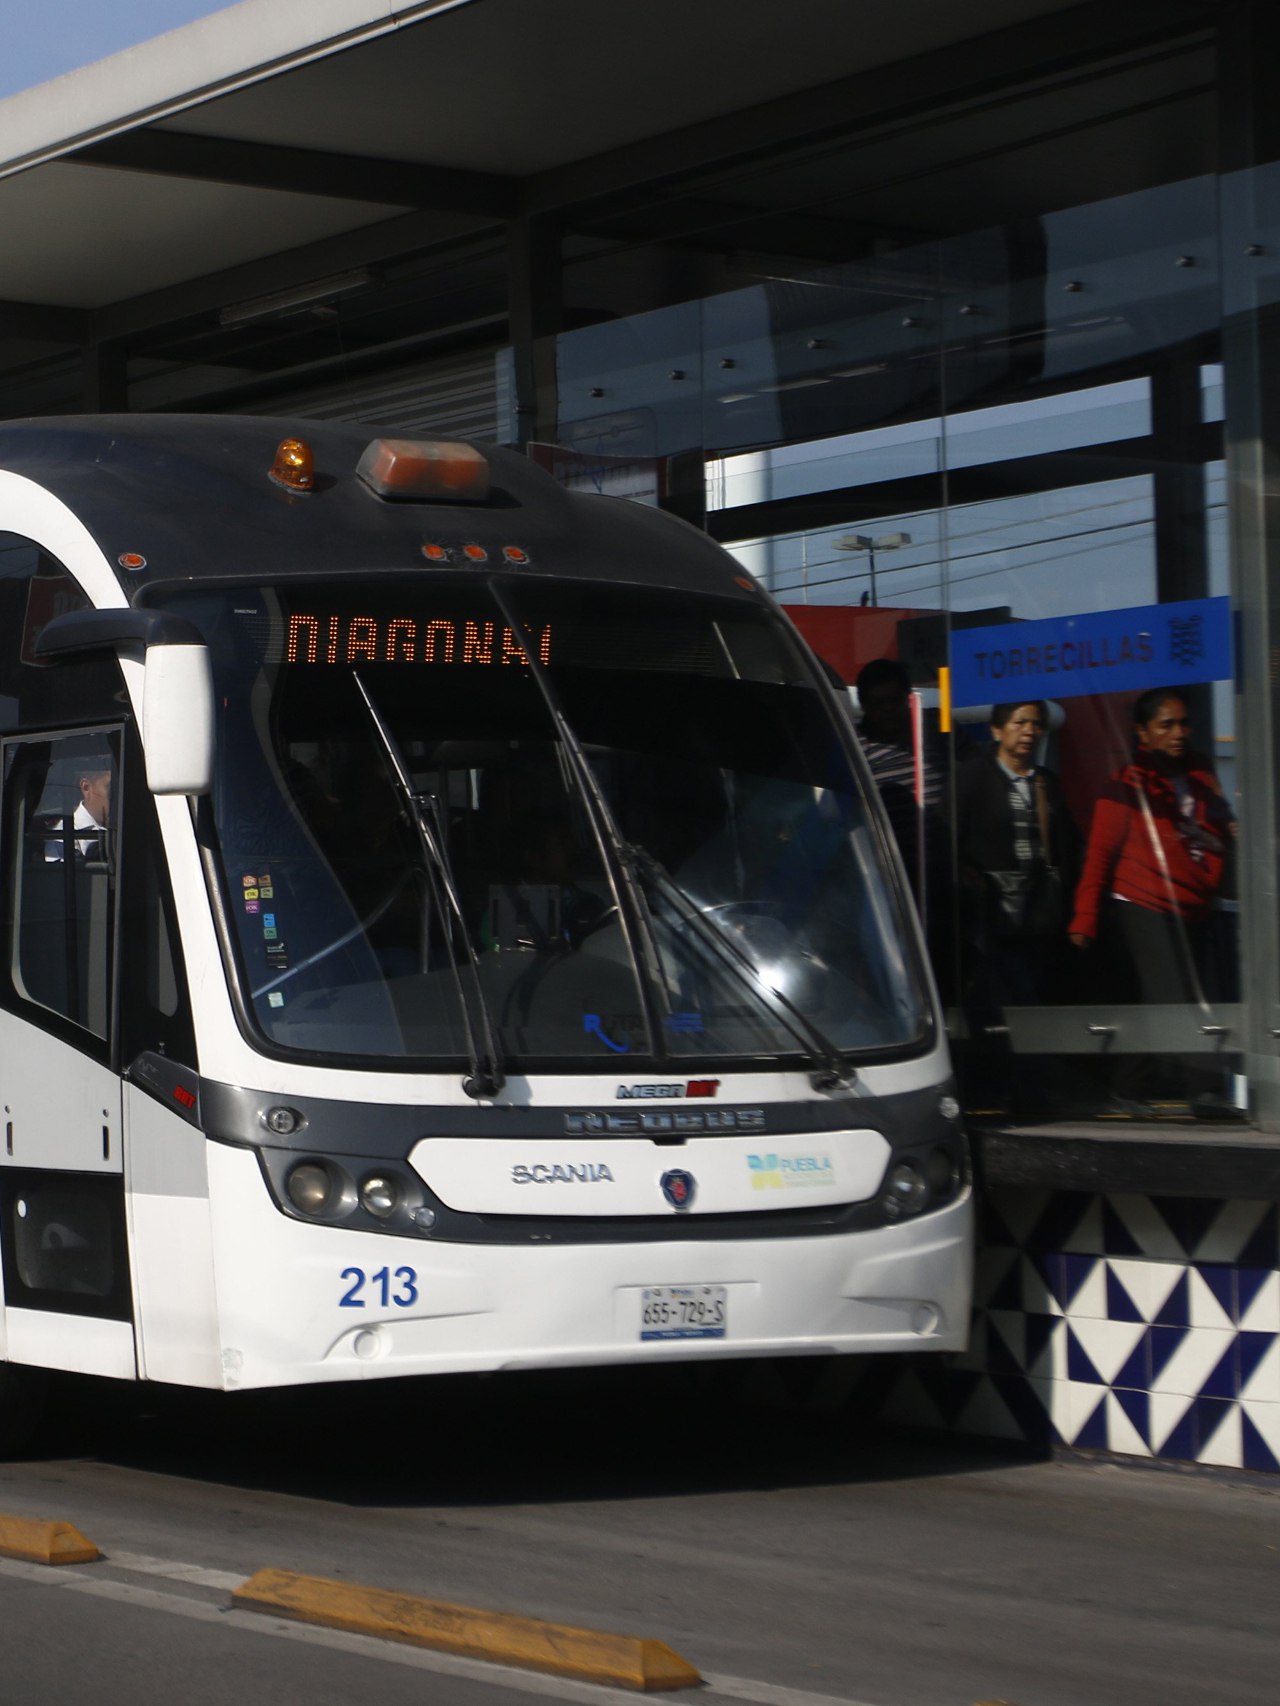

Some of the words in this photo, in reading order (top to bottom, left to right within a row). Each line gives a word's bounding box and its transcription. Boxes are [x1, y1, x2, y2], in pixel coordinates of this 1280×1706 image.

[974, 633, 1154, 680] TORRECILLAS
[616, 1083, 685, 1100] MEGA
[564, 1109, 765, 1136] NEOBUS
[511, 1163, 615, 1185] SCANIA
[781, 1157, 832, 1173] PUEBLA
[339, 1266, 419, 1308] 213
[643, 1300, 724, 1325] 655-729-S
